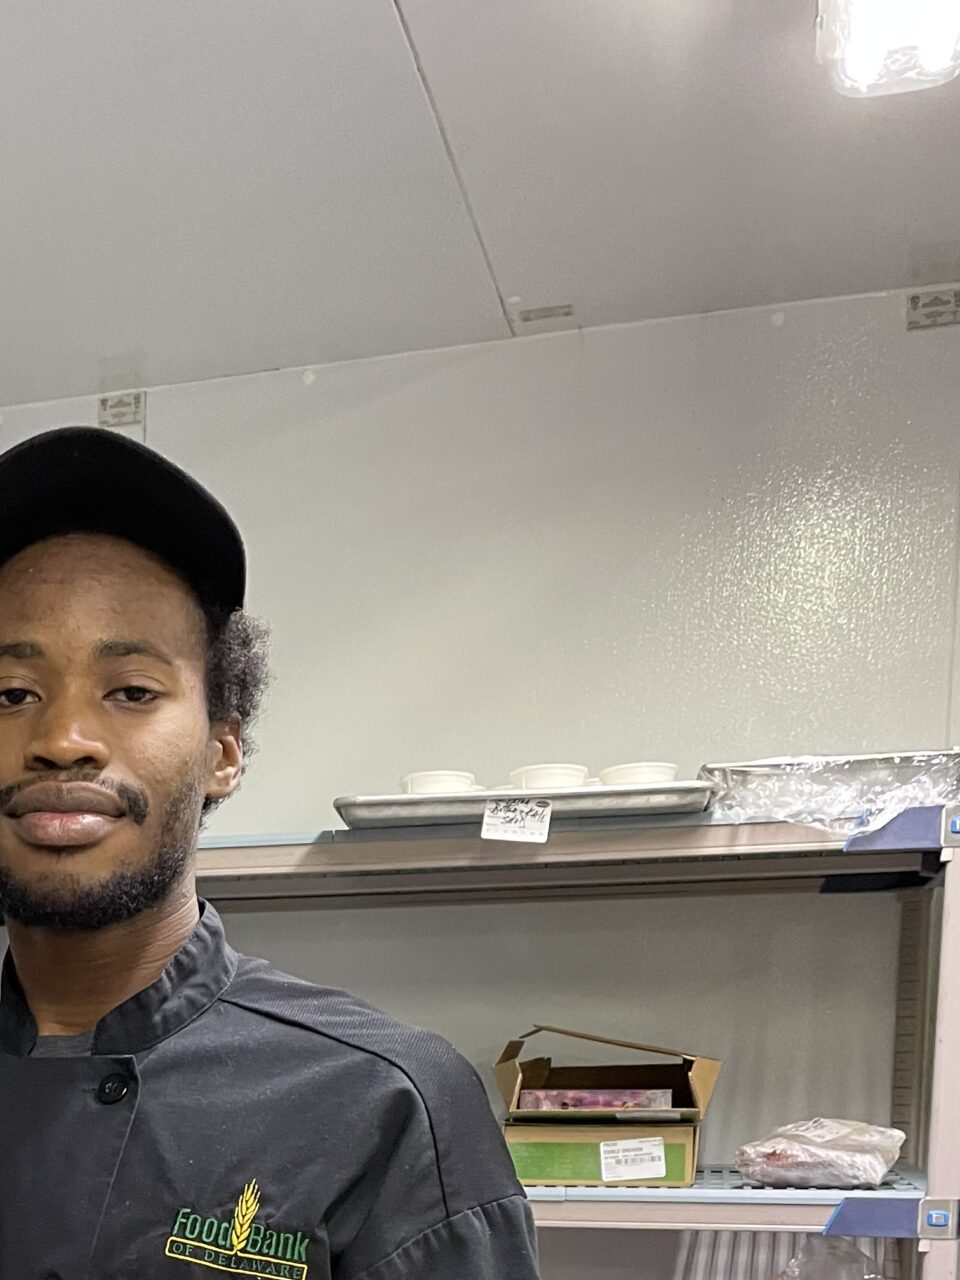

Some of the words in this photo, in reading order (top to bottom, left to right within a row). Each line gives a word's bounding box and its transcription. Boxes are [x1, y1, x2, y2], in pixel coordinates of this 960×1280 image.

[172, 1208, 235, 1248] Food
[247, 1223, 310, 1262] Bank
[172, 1242, 193, 1256] OF
[204, 1250, 302, 1279] DELAWARE
